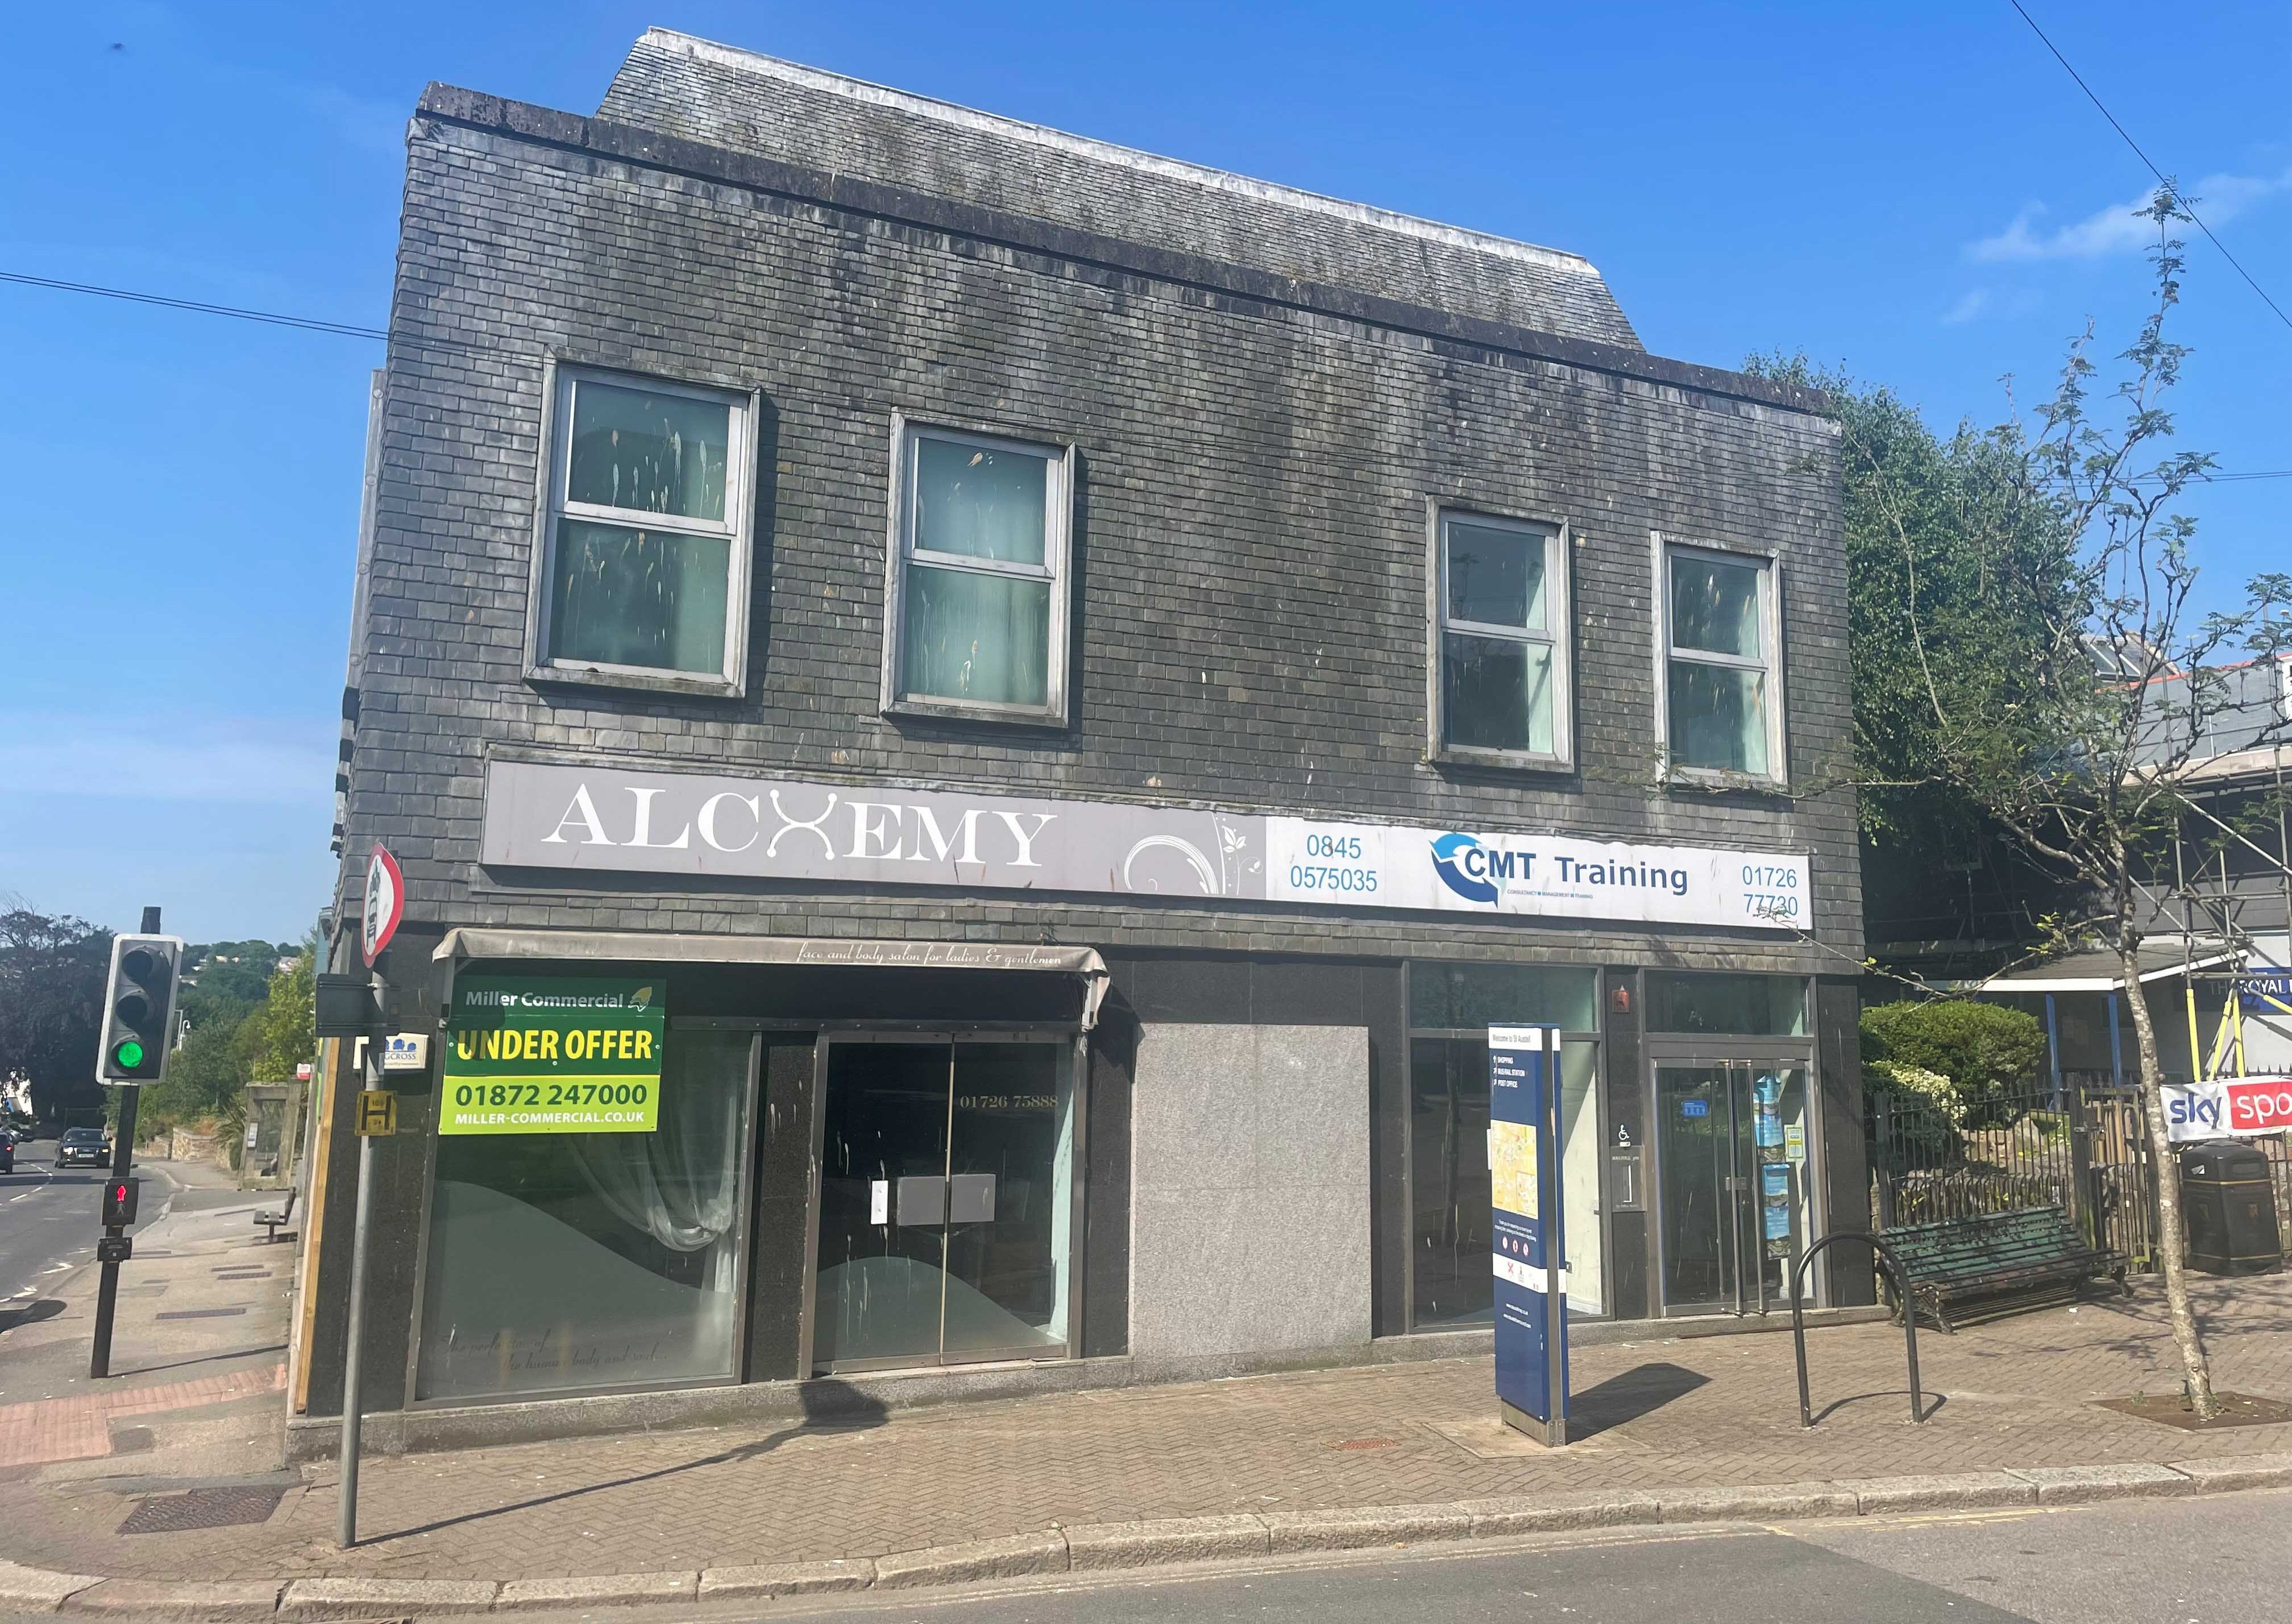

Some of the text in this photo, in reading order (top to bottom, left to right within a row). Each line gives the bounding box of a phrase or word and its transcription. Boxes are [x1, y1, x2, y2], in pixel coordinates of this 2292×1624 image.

[1307, 834, 1361, 859] 0845
[1290, 865, 1377, 891] 0575035
[1465, 848, 1688, 895] CMT Training
[1742, 865, 1797, 888] 01726
[797, 942, 1061, 967] face and body salon for ladies & gentlemen
[466, 991, 623, 1008] Miller Commercial
[457, 1029, 653, 1060] UNDER OFFER
[455, 1085, 647, 1106] 01872 247000
[960, 1095, 1058, 1108] 01726 75888
[455, 1111, 644, 1125] MILLER-COMMERCIAL.CO.UK
[2170, 1092, 2222, 1129] sky
